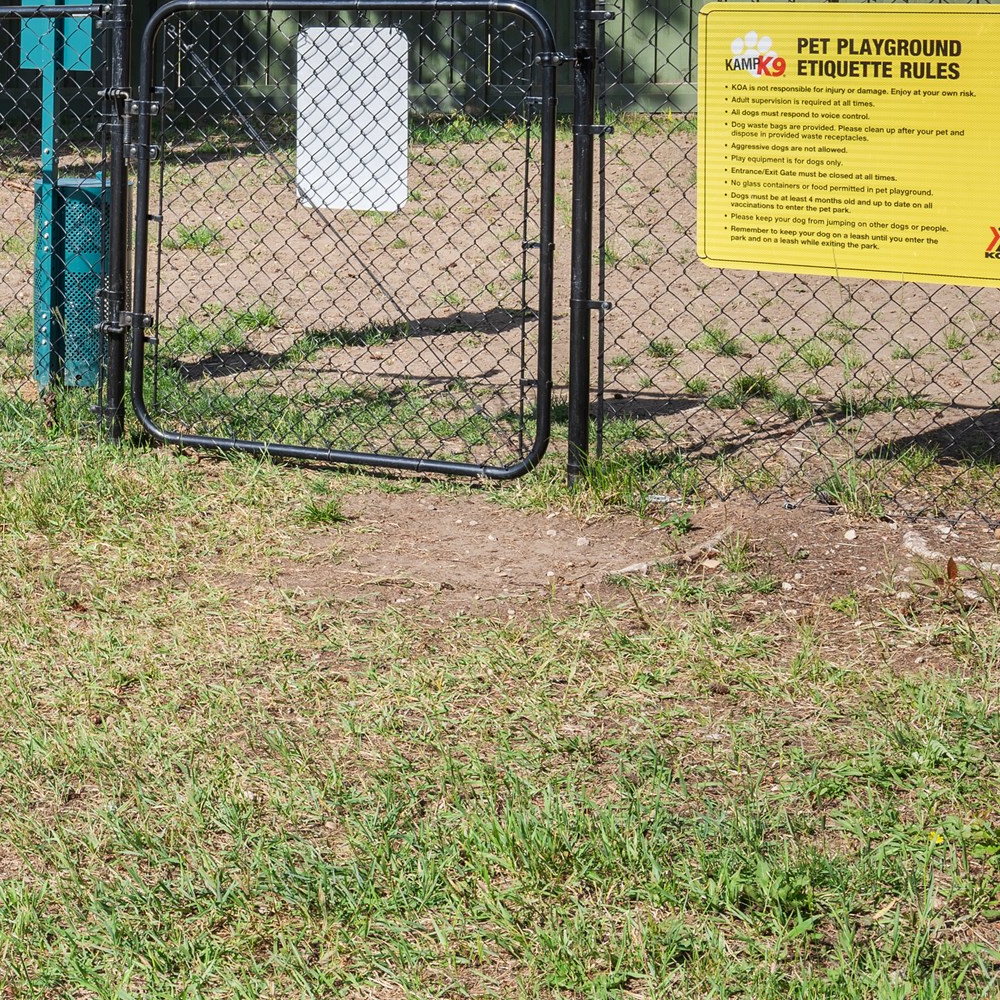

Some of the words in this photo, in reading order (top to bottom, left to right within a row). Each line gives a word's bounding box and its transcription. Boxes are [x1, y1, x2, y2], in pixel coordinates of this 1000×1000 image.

[797, 38, 830, 54] PET
[837, 38, 961, 56] PLAYGROUND
[797, 60, 892, 78] ETIQUETTE
[900, 62, 960, 79] RULES
[770, 85, 811, 93] responsible
[857, 88, 888, 96] damage.
[891, 88, 911, 96] Enjoy
[752, 97, 791, 105] supervision
[742, 109, 759, 117] dogs
[732, 121, 745, 129] Dog
[803, 124, 835, 132] provided.
[824, 133, 869, 142] receptacles.
[731, 143, 769, 151] Aggressive
[771, 144, 789, 152] dogs
[731, 155, 745, 163] Play
[747, 156, 785, 164] equipment
[806, 158, 824, 166] dogs
[826, 159, 843, 167] only.
[731, 167, 778, 175] Entrance/Exit
[830, 184, 864, 192] permitted
[889, 188, 933, 196] playground.
[731, 192, 749, 200] Dogs
[815, 196, 842, 204] months
[756, 214, 773, 222] keep
[792, 217, 806, 225] dog
[826, 219, 855, 228] jumping
[891, 222, 909, 231] dogs
[921, 225, 948, 233] people.
[817, 231, 830, 239] dog
[821, 241, 845, 249] exiting
